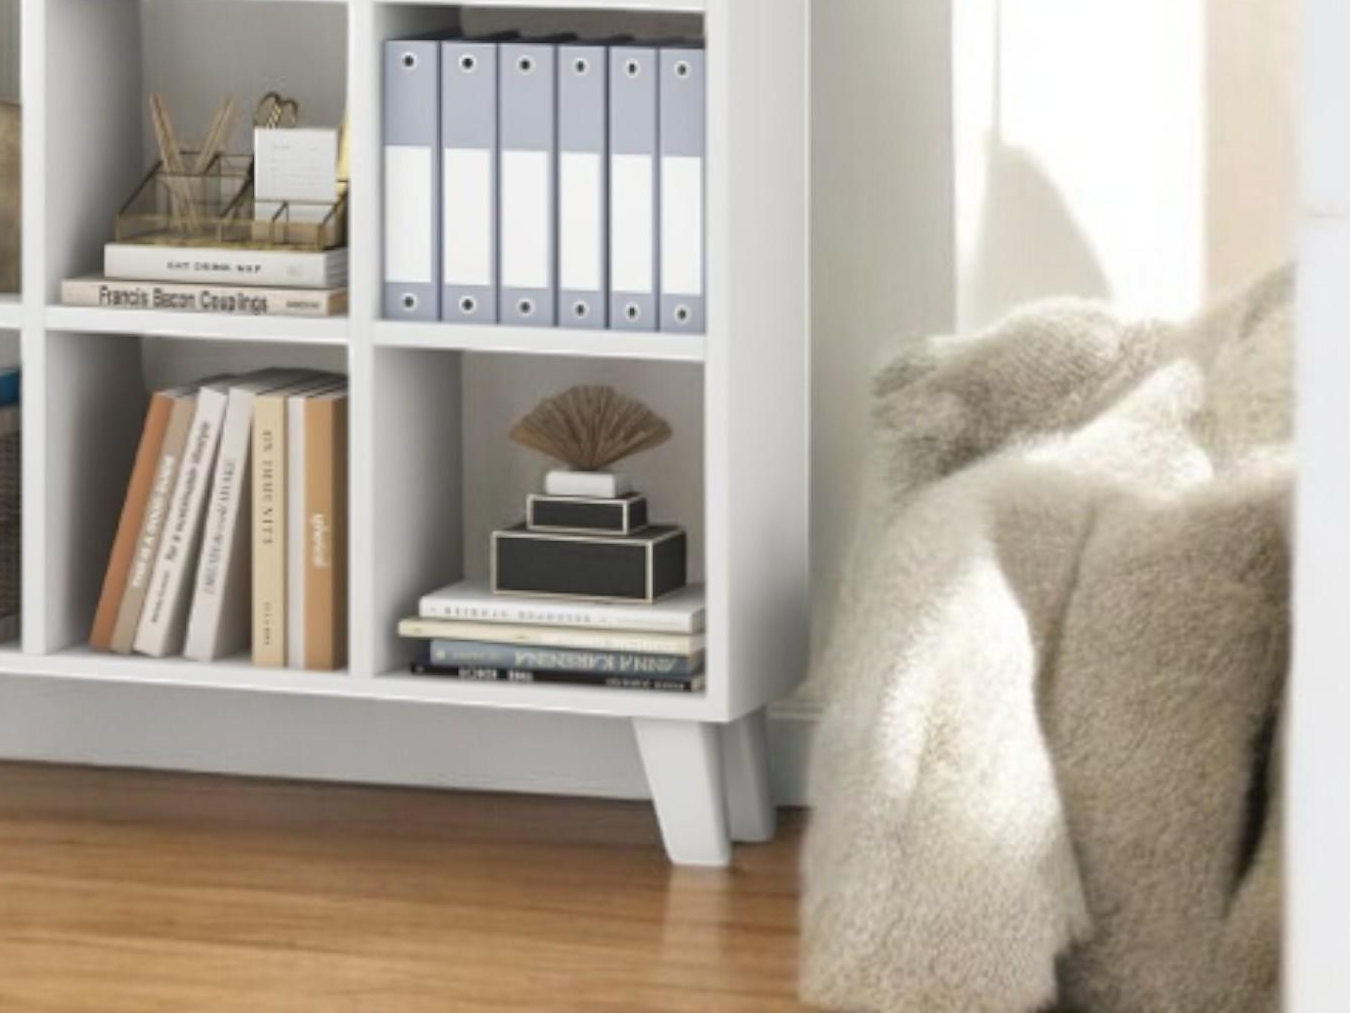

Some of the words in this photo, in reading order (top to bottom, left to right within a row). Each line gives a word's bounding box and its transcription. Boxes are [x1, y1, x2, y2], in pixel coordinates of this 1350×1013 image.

[99, 286, 148, 307] Francis
[153, 288, 196, 309] Bacon
[200, 290, 269, 315] Couplings
